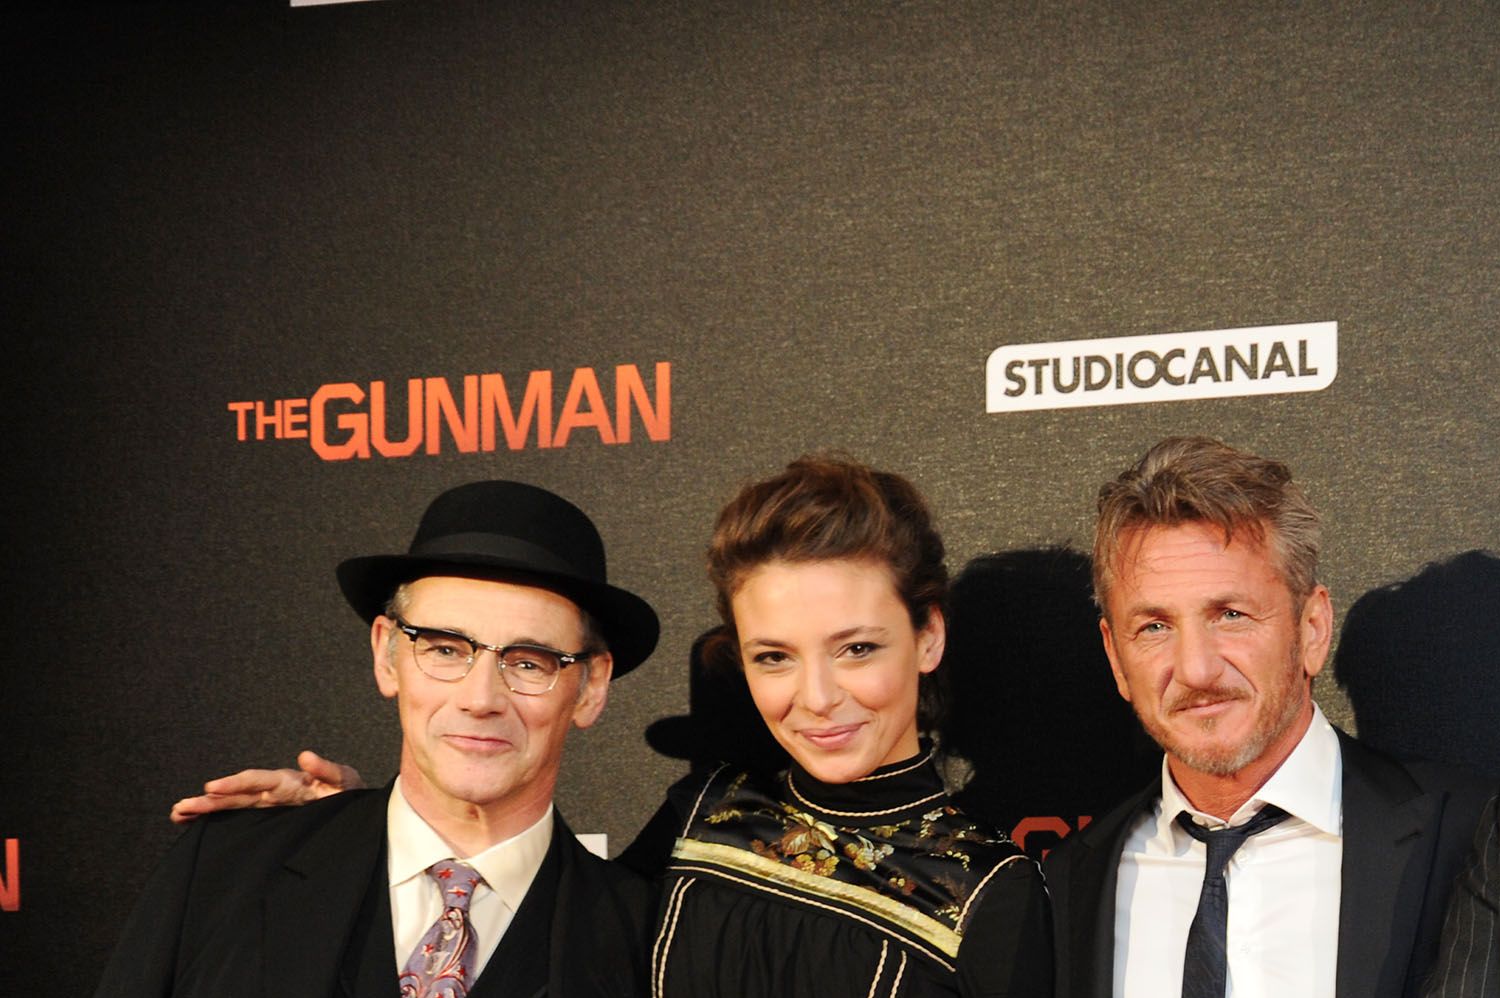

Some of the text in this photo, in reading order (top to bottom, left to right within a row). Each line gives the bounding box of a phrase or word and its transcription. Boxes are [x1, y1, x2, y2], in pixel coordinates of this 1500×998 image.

[1003, 339, 1318, 398] STUDIOCANAL
[228, 361, 671, 461] THE GUNMAN
